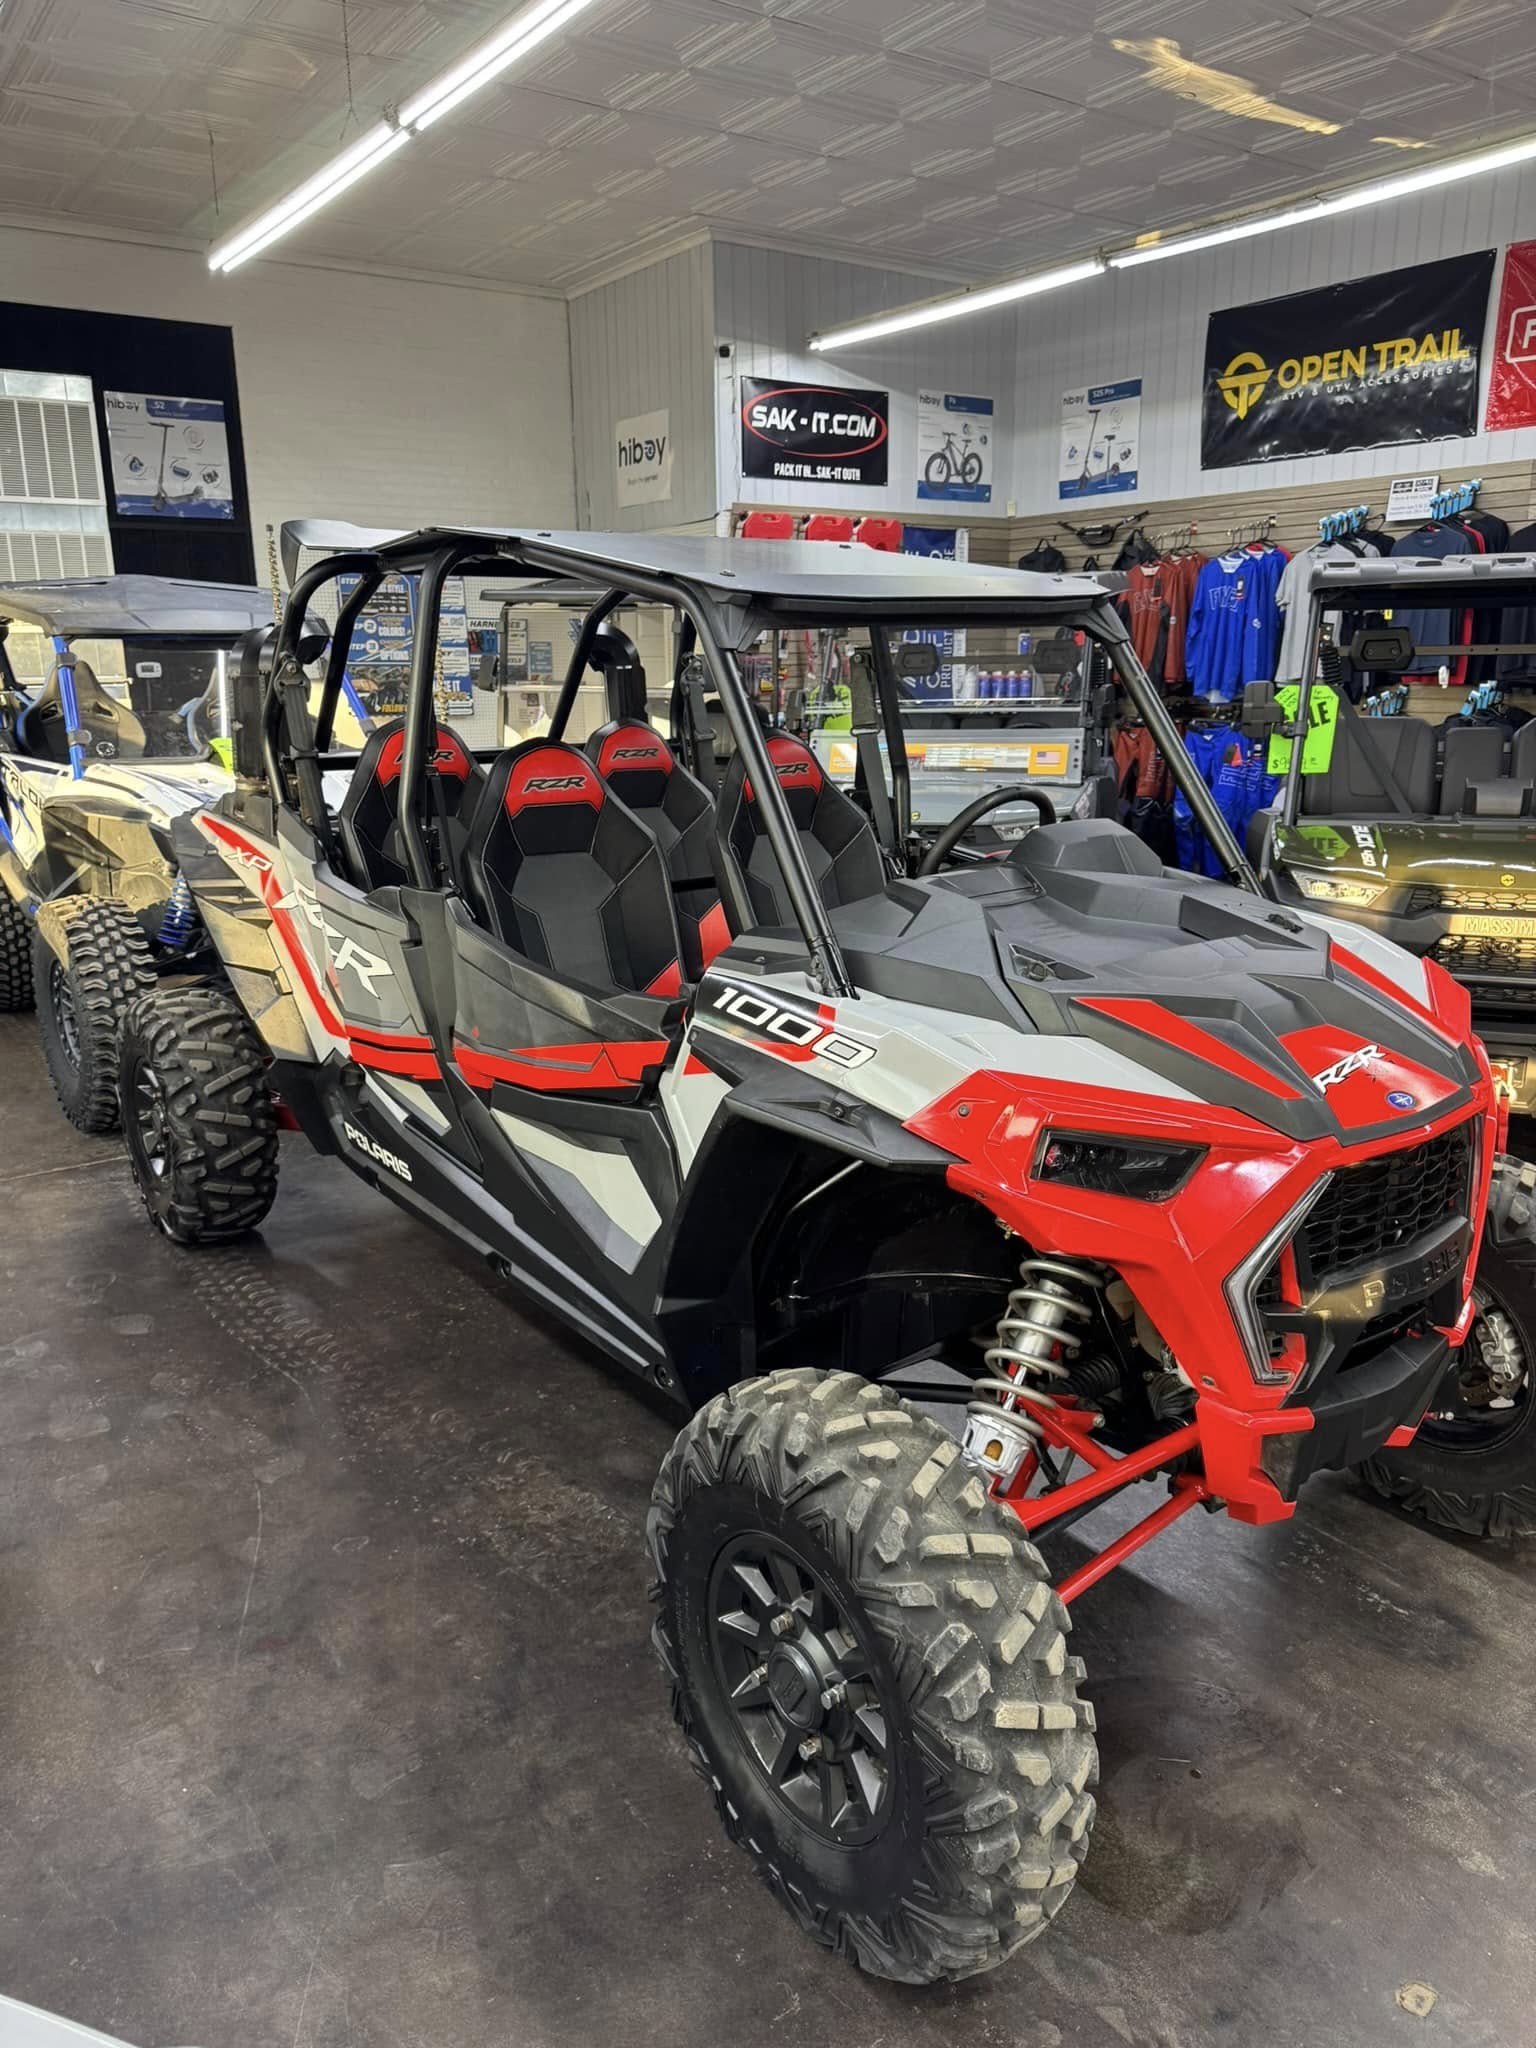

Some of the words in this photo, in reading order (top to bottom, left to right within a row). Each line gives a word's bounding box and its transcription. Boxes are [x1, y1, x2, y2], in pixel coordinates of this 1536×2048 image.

[1278, 346, 1367, 389] OPEN
[1373, 328, 1470, 373] TRAIL
[1327, 383, 1351, 394] UTV
[1359, 365, 1454, 389] ACCESSORIES
[751, 405, 797, 431] SAK
[811, 411, 877, 438] IT.COM
[618, 436, 666, 468] hiboy
[774, 462, 795, 476] PACK
[611, 748, 659, 761] RZR
[523, 776, 586, 794] RZR
[228, 846, 273, 872] XP
[1463, 915, 1536, 937] MASSIM
[711, 986, 878, 1069] 1000
[1310, 1044, 1386, 1095] RZR
[343, 1122, 413, 1183] POLARIS
